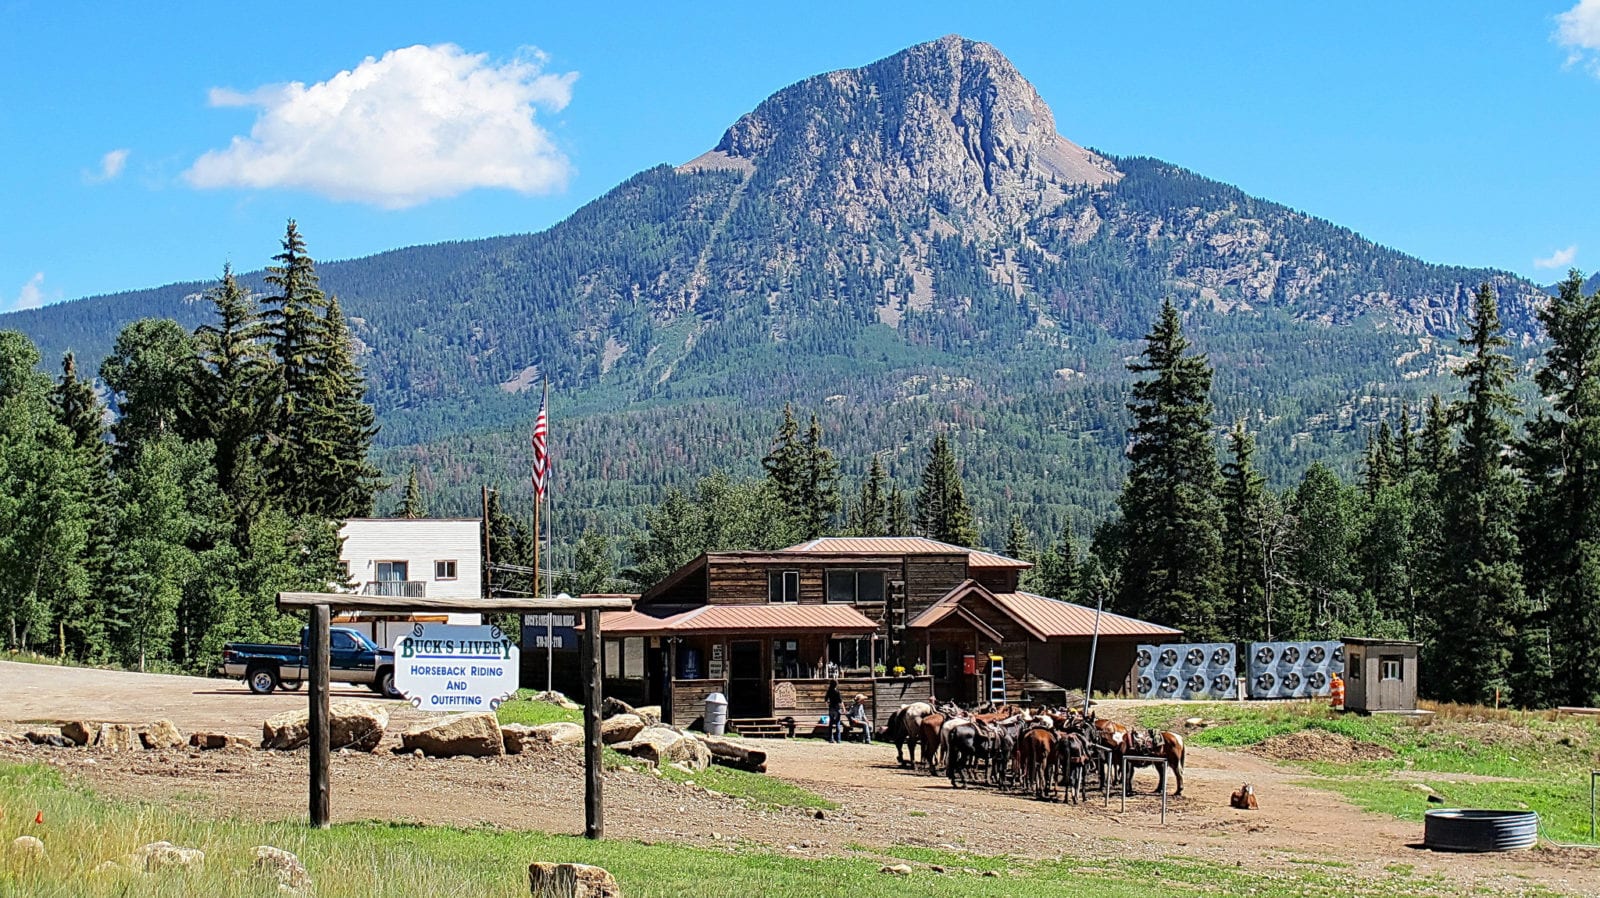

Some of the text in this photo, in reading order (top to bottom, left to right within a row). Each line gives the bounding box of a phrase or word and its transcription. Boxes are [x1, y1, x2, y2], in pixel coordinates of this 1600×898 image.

[539, 615, 552, 627] LIVE
[401, 637, 512, 660] BUCK'S LIVERY
[410, 665, 504, 677] HORSEBACK RIDING
[446, 680, 467, 691] AND
[431, 695, 482, 705] OUTFITTING
